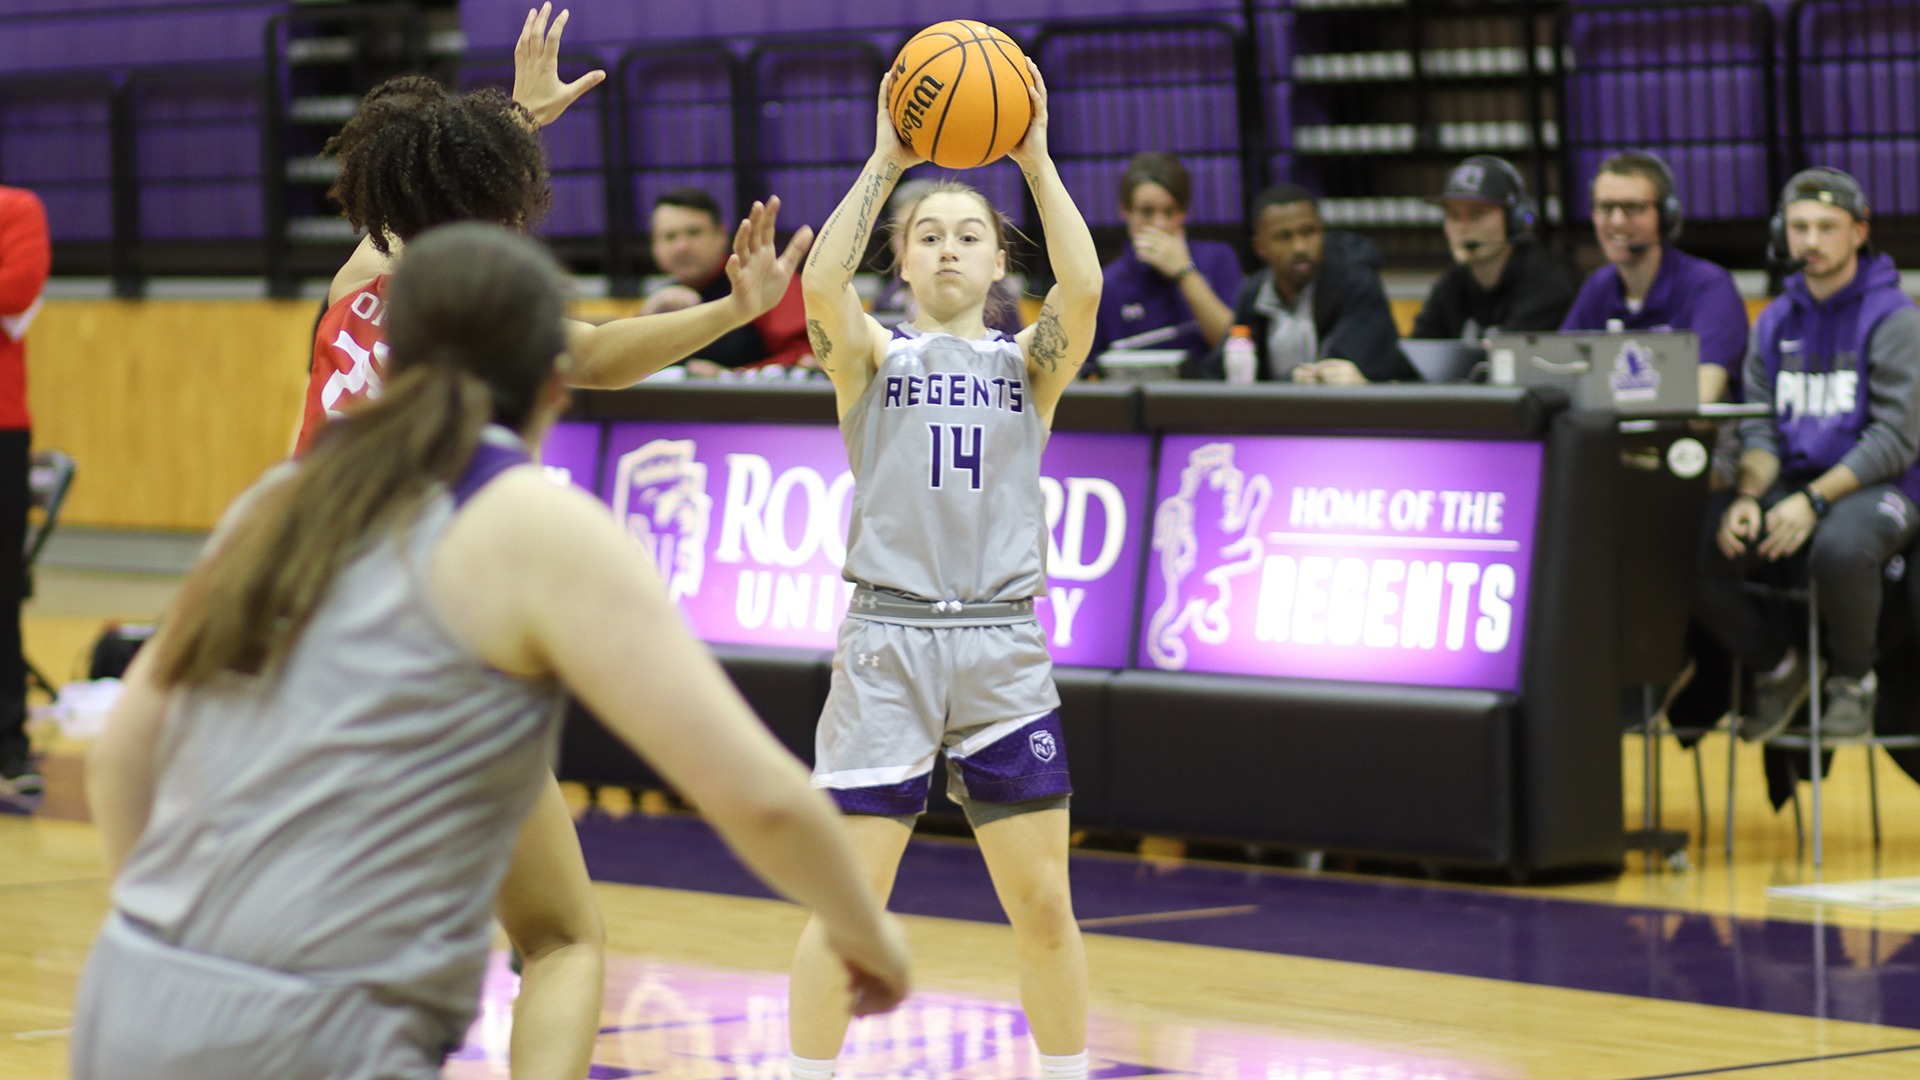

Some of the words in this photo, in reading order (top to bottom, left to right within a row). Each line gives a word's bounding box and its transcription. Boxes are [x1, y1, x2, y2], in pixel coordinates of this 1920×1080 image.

[884, 372, 1024, 414] REGENTS
[926, 421, 985, 492] 14
[1290, 486, 1386, 530] HOME
[1389, 489, 1436, 532] OF
[1438, 490, 1506, 534] THE
[1255, 554, 1516, 653] REGENTS
